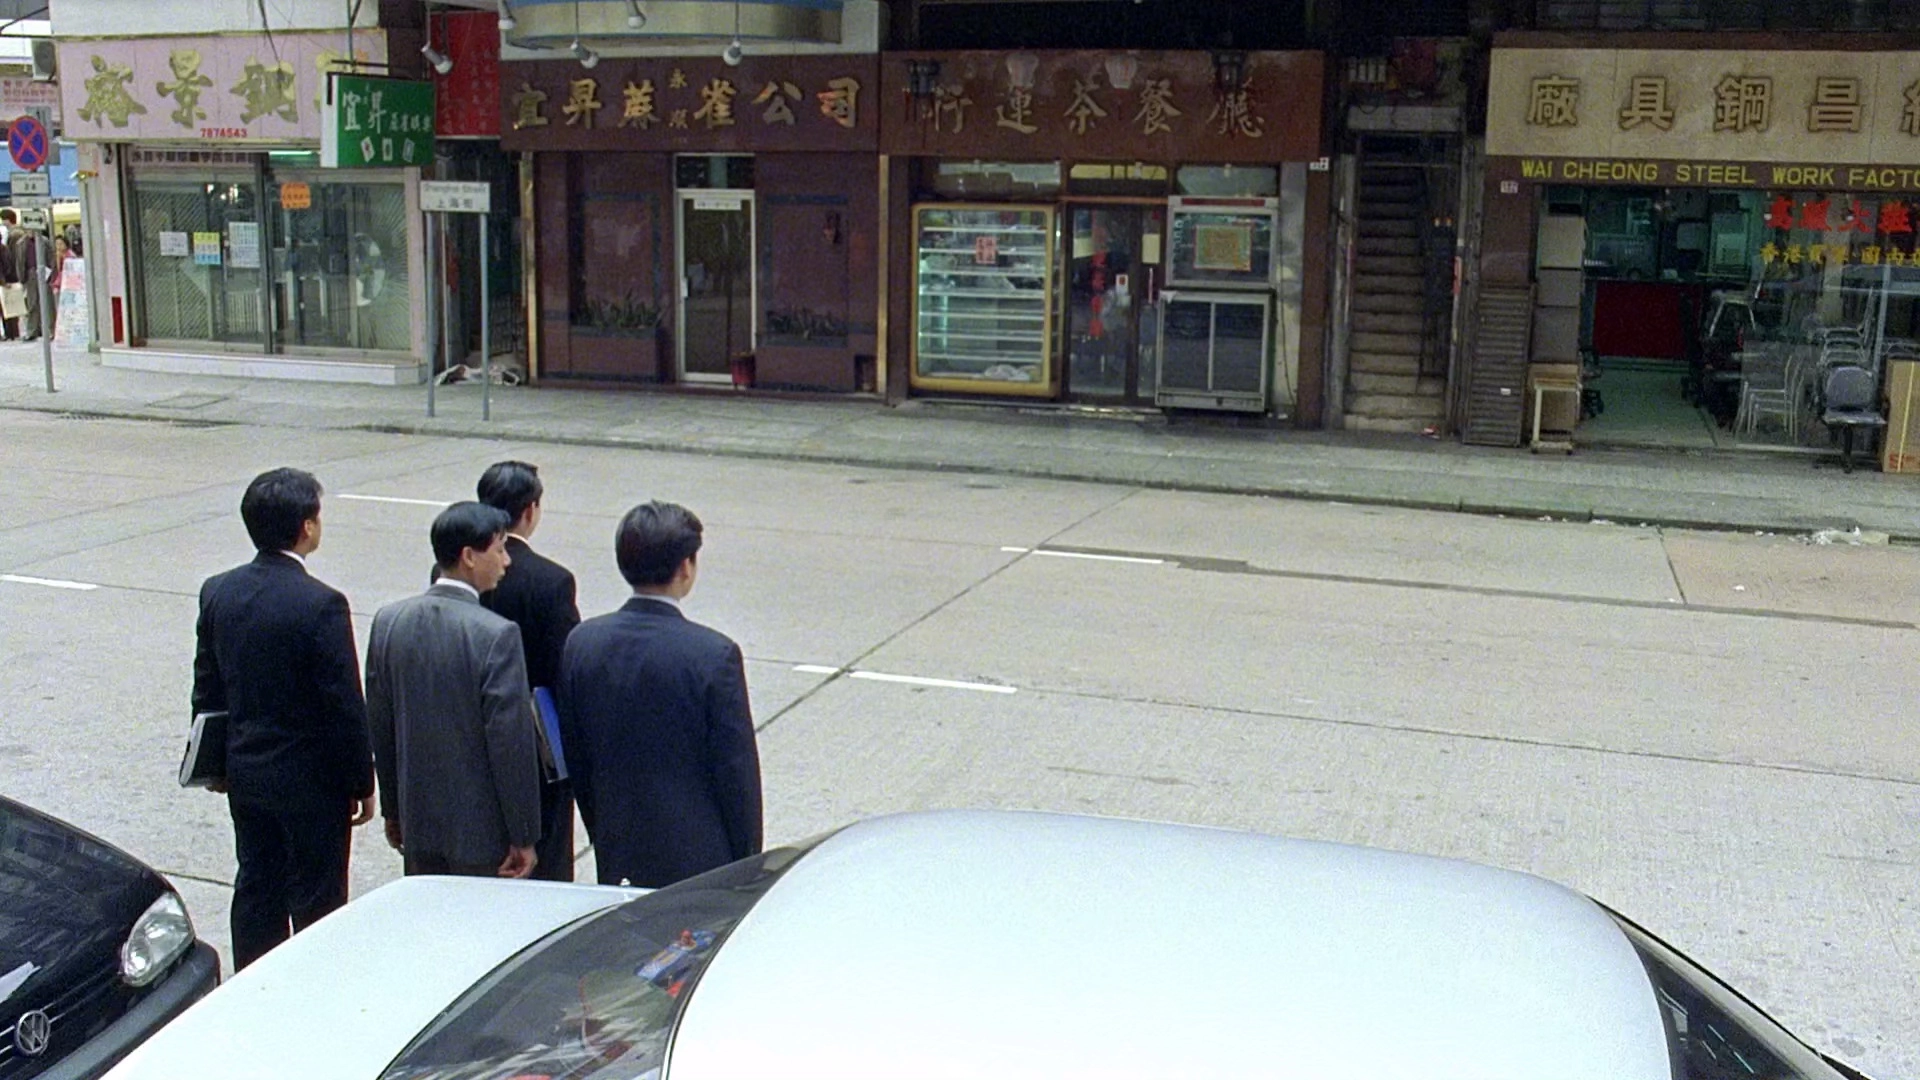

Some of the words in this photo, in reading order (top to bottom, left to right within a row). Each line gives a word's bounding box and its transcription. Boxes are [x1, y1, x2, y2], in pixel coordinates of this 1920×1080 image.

[200, 127, 248, 138] 7874543
[1520, 159, 1553, 178] WAI
[1563, 161, 1659, 180] CHEONG
[1676, 164, 1756, 185] STEEL
[1772, 166, 1836, 186] WORK
